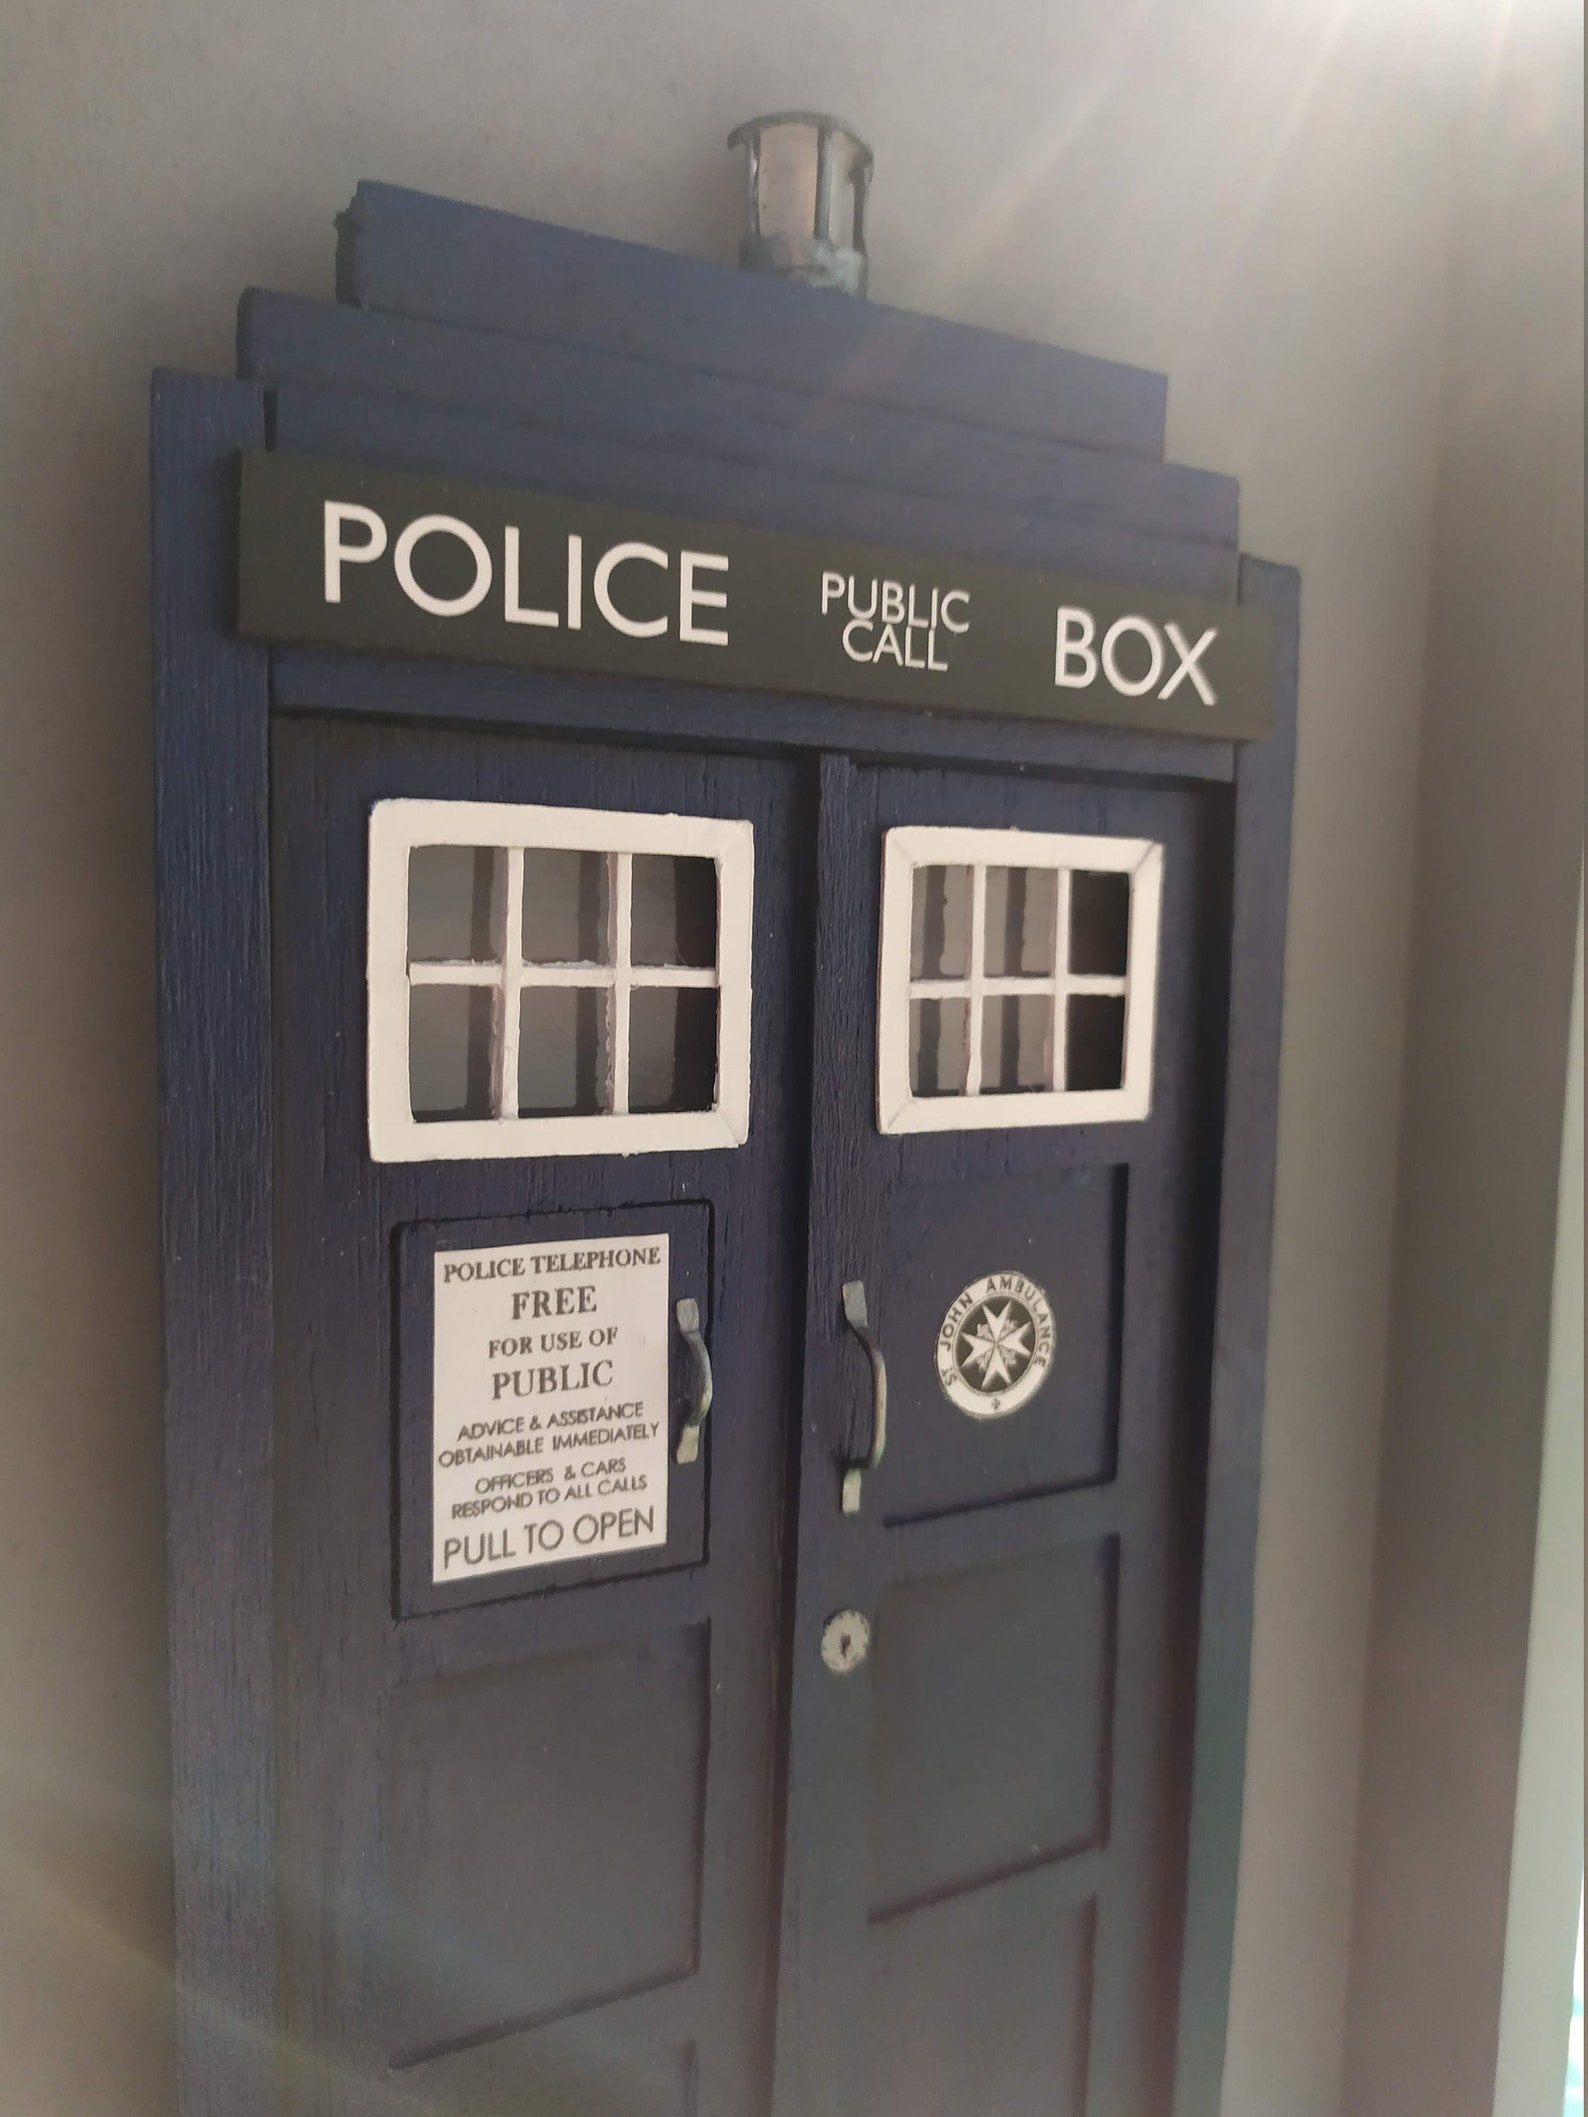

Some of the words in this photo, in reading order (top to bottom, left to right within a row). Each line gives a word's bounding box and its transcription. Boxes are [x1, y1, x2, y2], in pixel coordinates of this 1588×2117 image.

[323, 499, 730, 647] POLICE
[820, 571, 970, 633] PUBLIC
[842, 620, 948, 672] CALL
[1054, 606, 1218, 706] BOX
[444, 1257, 526, 1283] POLICE
[531, 1247, 661, 1275] TELEPHONE
[511, 1286, 597, 1320] FREE
[940, 1292, 973, 1350] JOHN
[986, 1276, 1050, 1367] AMBULANCE
[488, 1336, 533, 1358] FOR
[541, 1331, 582, 1353] USE
[589, 1327, 618, 1346] OF
[492, 1360, 613, 1400] PUBLIC
[457, 1416, 524, 1442] ADVICE
[529, 1415, 542, 1431] &
[547, 1401, 643, 1429] ASSISTANCE
[438, 1437, 544, 1468] OBTAINABLE
[552, 1422, 659, 1451] IMMEDIATELY
[451, 1492, 533, 1519] RESPOND
[537, 1488, 560, 1505] TO
[565, 1485, 592, 1499] ALL
[597, 1474, 647, 1494] CALLS
[475, 1468, 553, 1494] OFFICERS
[564, 1465, 576, 1481] &
[581, 1457, 626, 1477] CARS
[444, 1528, 516, 1570] PULL
[524, 1520, 564, 1553] TO
[573, 1505, 654, 1544] OPEN
